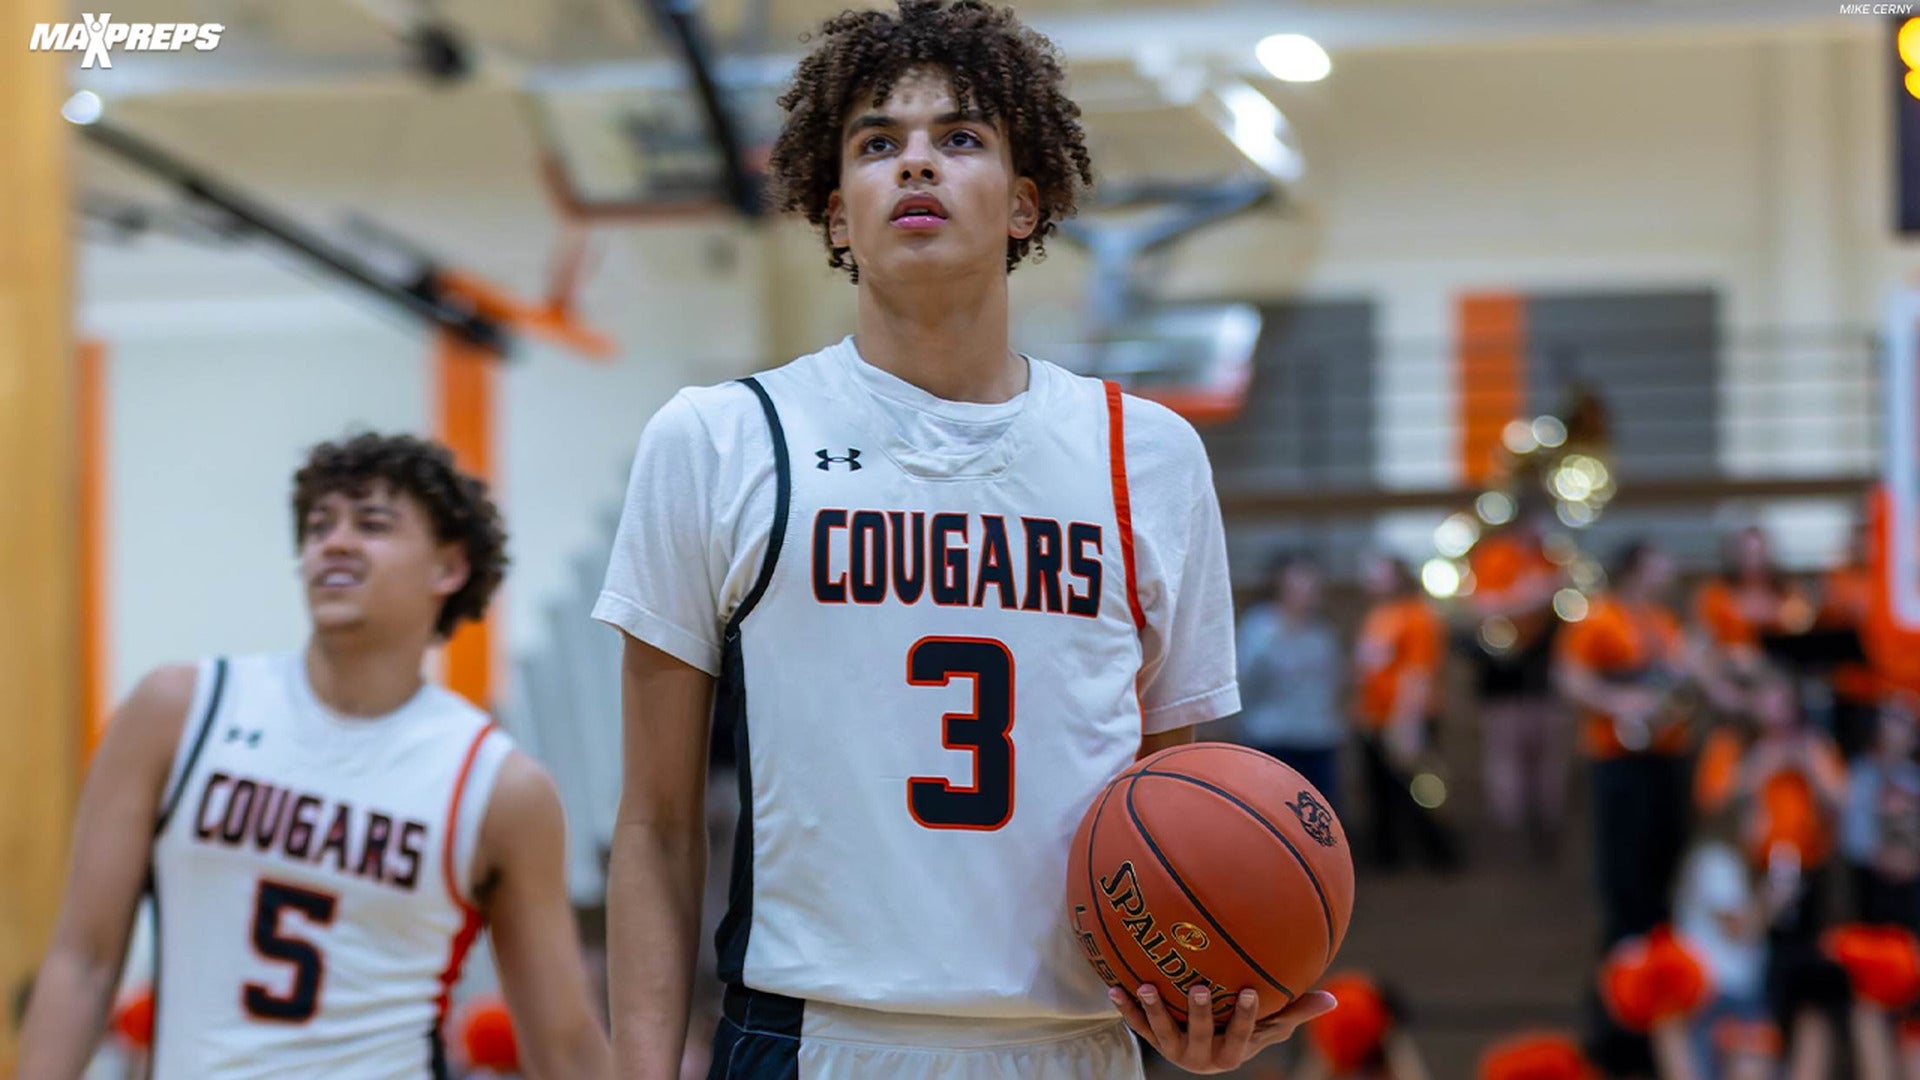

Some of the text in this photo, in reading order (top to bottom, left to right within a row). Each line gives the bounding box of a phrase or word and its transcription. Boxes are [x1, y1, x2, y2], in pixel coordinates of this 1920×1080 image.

[811, 508, 1103, 618] COUGARS
[906, 635, 1015, 831] 3
[194, 772, 427, 889] COUGARS
[241, 877, 339, 1024] 5
